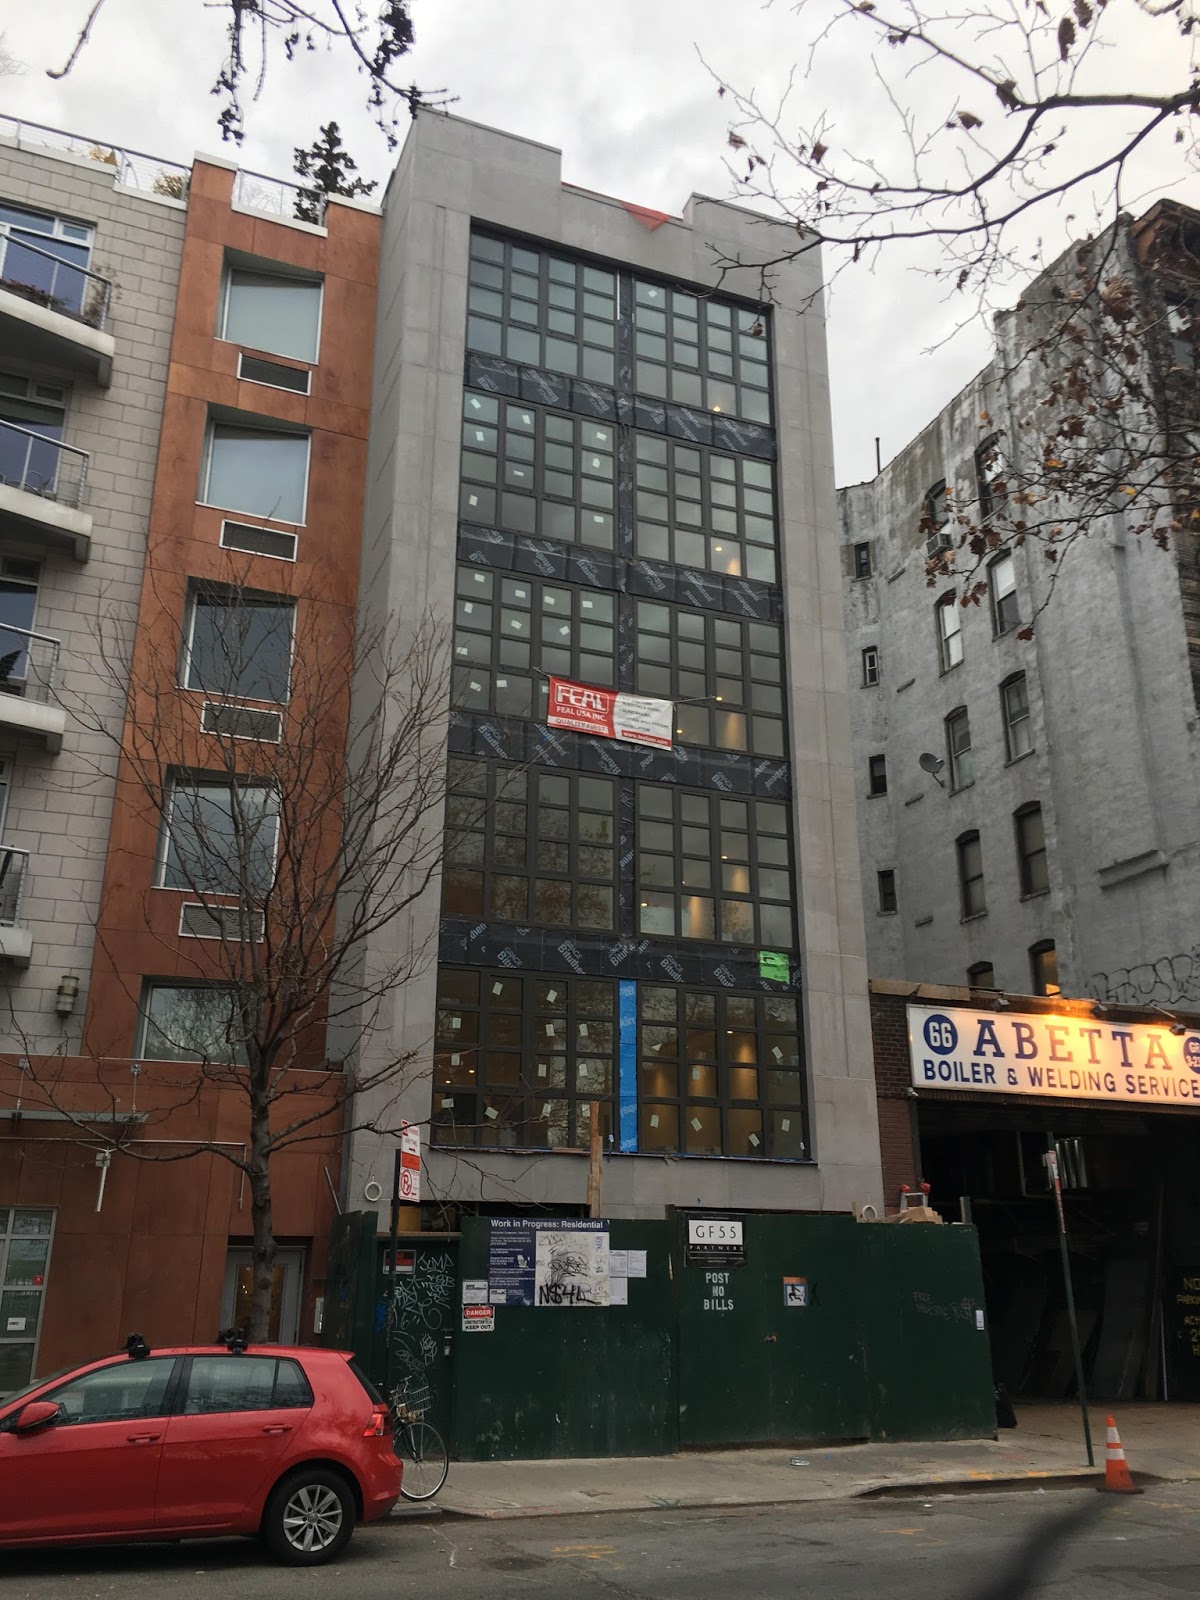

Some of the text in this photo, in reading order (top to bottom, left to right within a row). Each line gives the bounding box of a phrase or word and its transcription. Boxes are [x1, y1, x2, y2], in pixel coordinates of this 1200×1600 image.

[557, 686, 606, 711] FEAL
[556, 706, 607, 722] FEAL USA INC.
[556, 718, 606, 731] QUALITY FIRST
[928, 1021, 953, 1048] 66
[973, 1019, 1173, 1070] ABETTA
[923, 1060, 997, 1084] BOILER
[1007, 1067, 1019, 1085] &
[1027, 1066, 1117, 1092] WELDING
[522, 1220, 560, 1229] Progress:
[561, 1221, 603, 1229] Residential
[696, 1225, 737, 1239] GF55
[705, 1272, 730, 1284] POST
[712, 1286, 724, 1297] NO
[704, 1299, 734, 1310] BILLS
